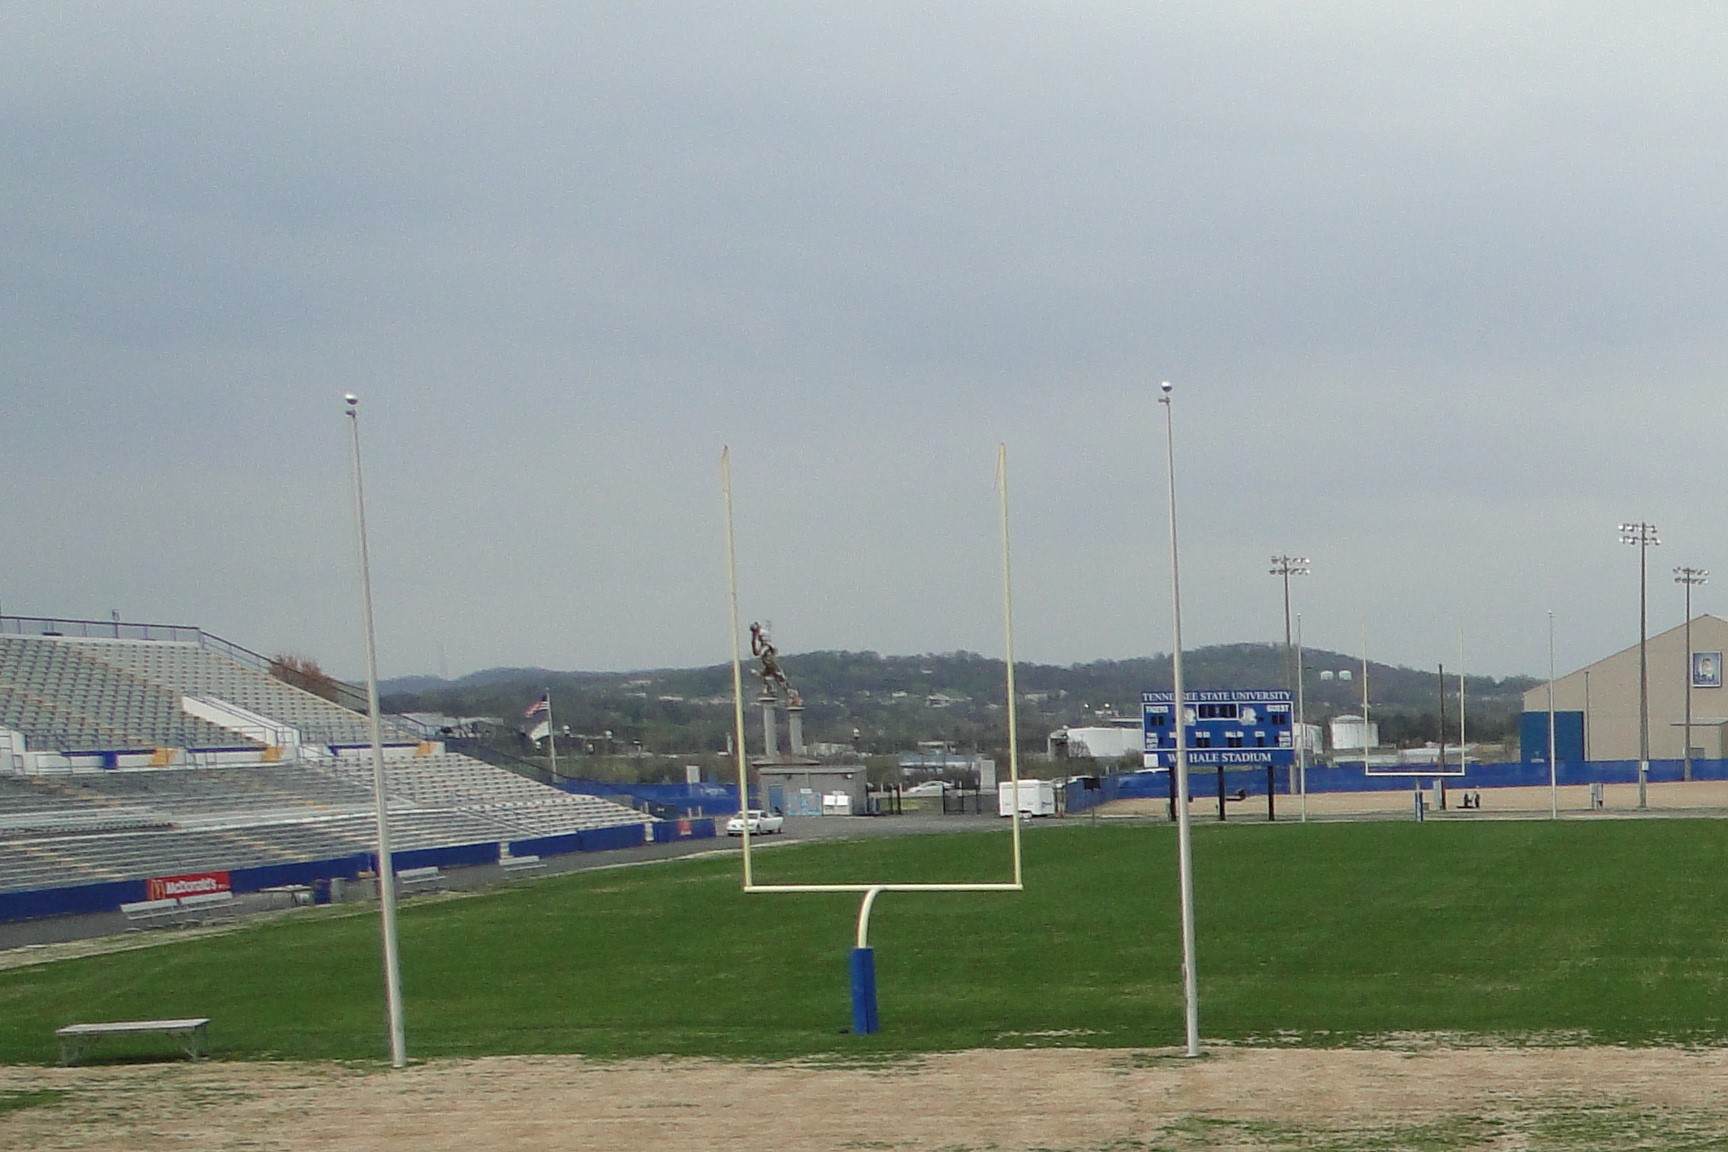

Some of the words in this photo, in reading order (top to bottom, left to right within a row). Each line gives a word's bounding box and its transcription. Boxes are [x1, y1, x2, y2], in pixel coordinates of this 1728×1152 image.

[1142, 692, 1198, 701] TENNEEE
[1200, 692, 1230, 700] STATE
[1232, 691, 1291, 700] UNIVERSITY
[1189, 753, 1219, 763] HALE
[1222, 753, 1272, 763] STADIUM
